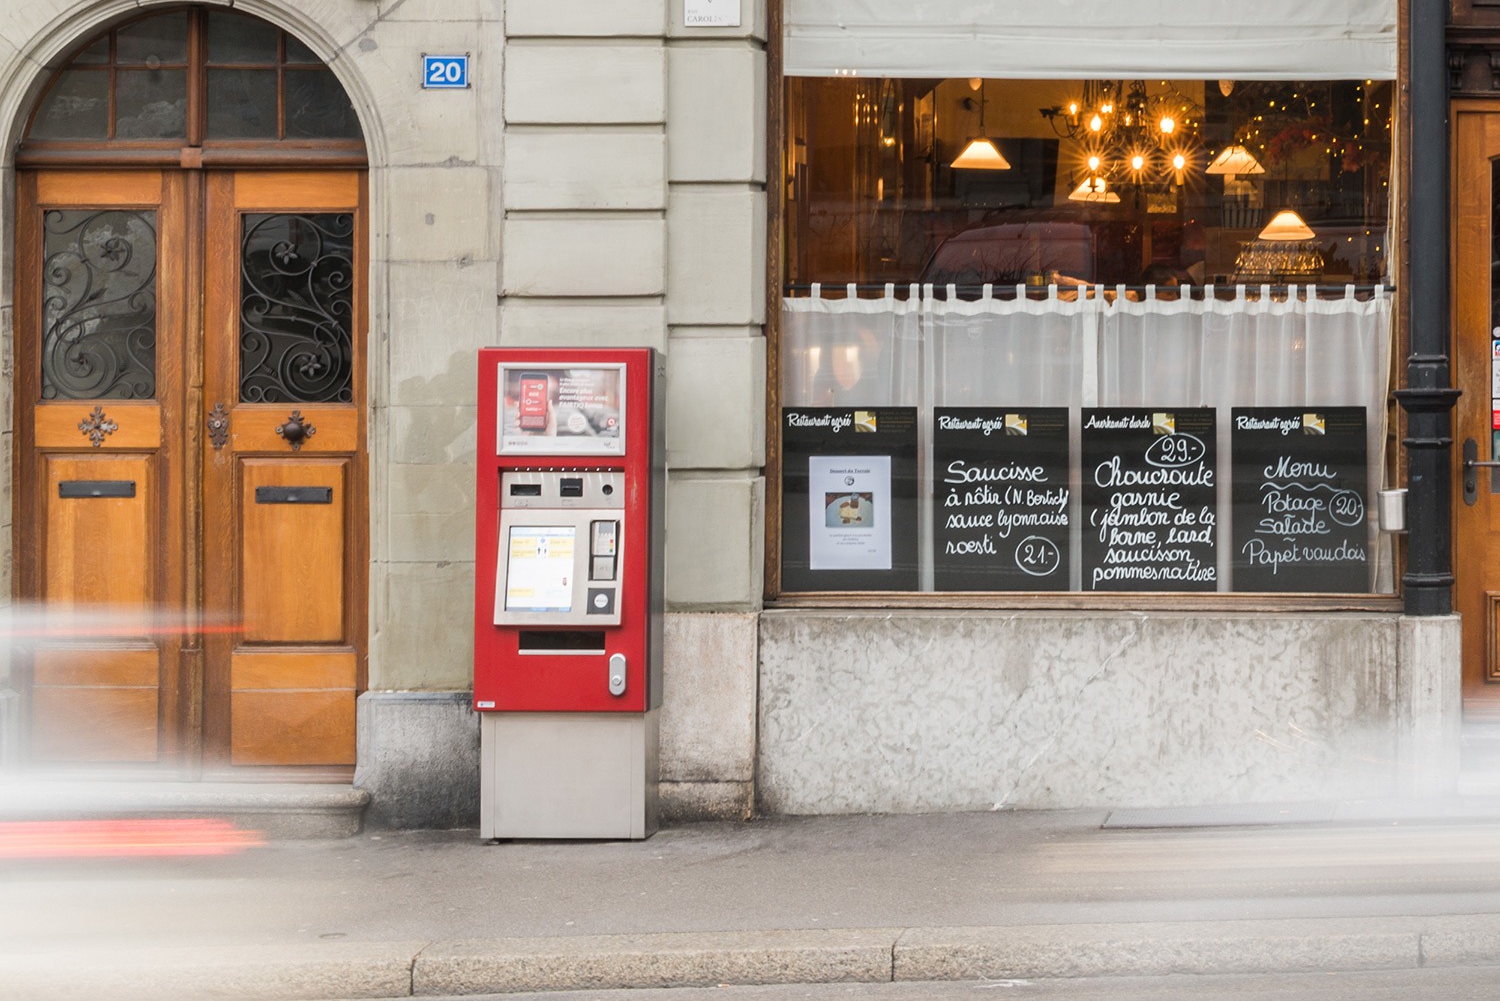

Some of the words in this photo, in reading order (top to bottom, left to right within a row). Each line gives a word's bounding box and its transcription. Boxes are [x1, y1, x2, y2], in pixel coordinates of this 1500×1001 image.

[430, 62, 461, 82] 20
[786, 412, 832, 427] Restaurant
[938, 415, 982, 430] Restaurant
[1084, 415, 1128, 429] Anerkannt
[1129, 414, 1151, 429] durch
[1236, 415, 1281, 430] Restaurant
[944, 460, 1048, 483] Saucisse
[1095, 455, 1214, 488] Choucroute
[1264, 456, 1337, 479] Menu
[944, 488, 961, 507] à
[965, 484, 1002, 506] rôtir
[1110, 488, 1182, 521] garnie
[1262, 492, 1327, 519] Potage
[945, 514, 993, 529] sauce
[998, 509, 1069, 538] lyonnaise
[1174, 509, 1196, 526] de
[1199, 506, 1216, 526] la
[1255, 517, 1330, 535] Salade
[946, 534, 997, 554] roesti
[1242, 539, 1301, 574] Papet
[1302, 540, 1366, 561] vaudois
